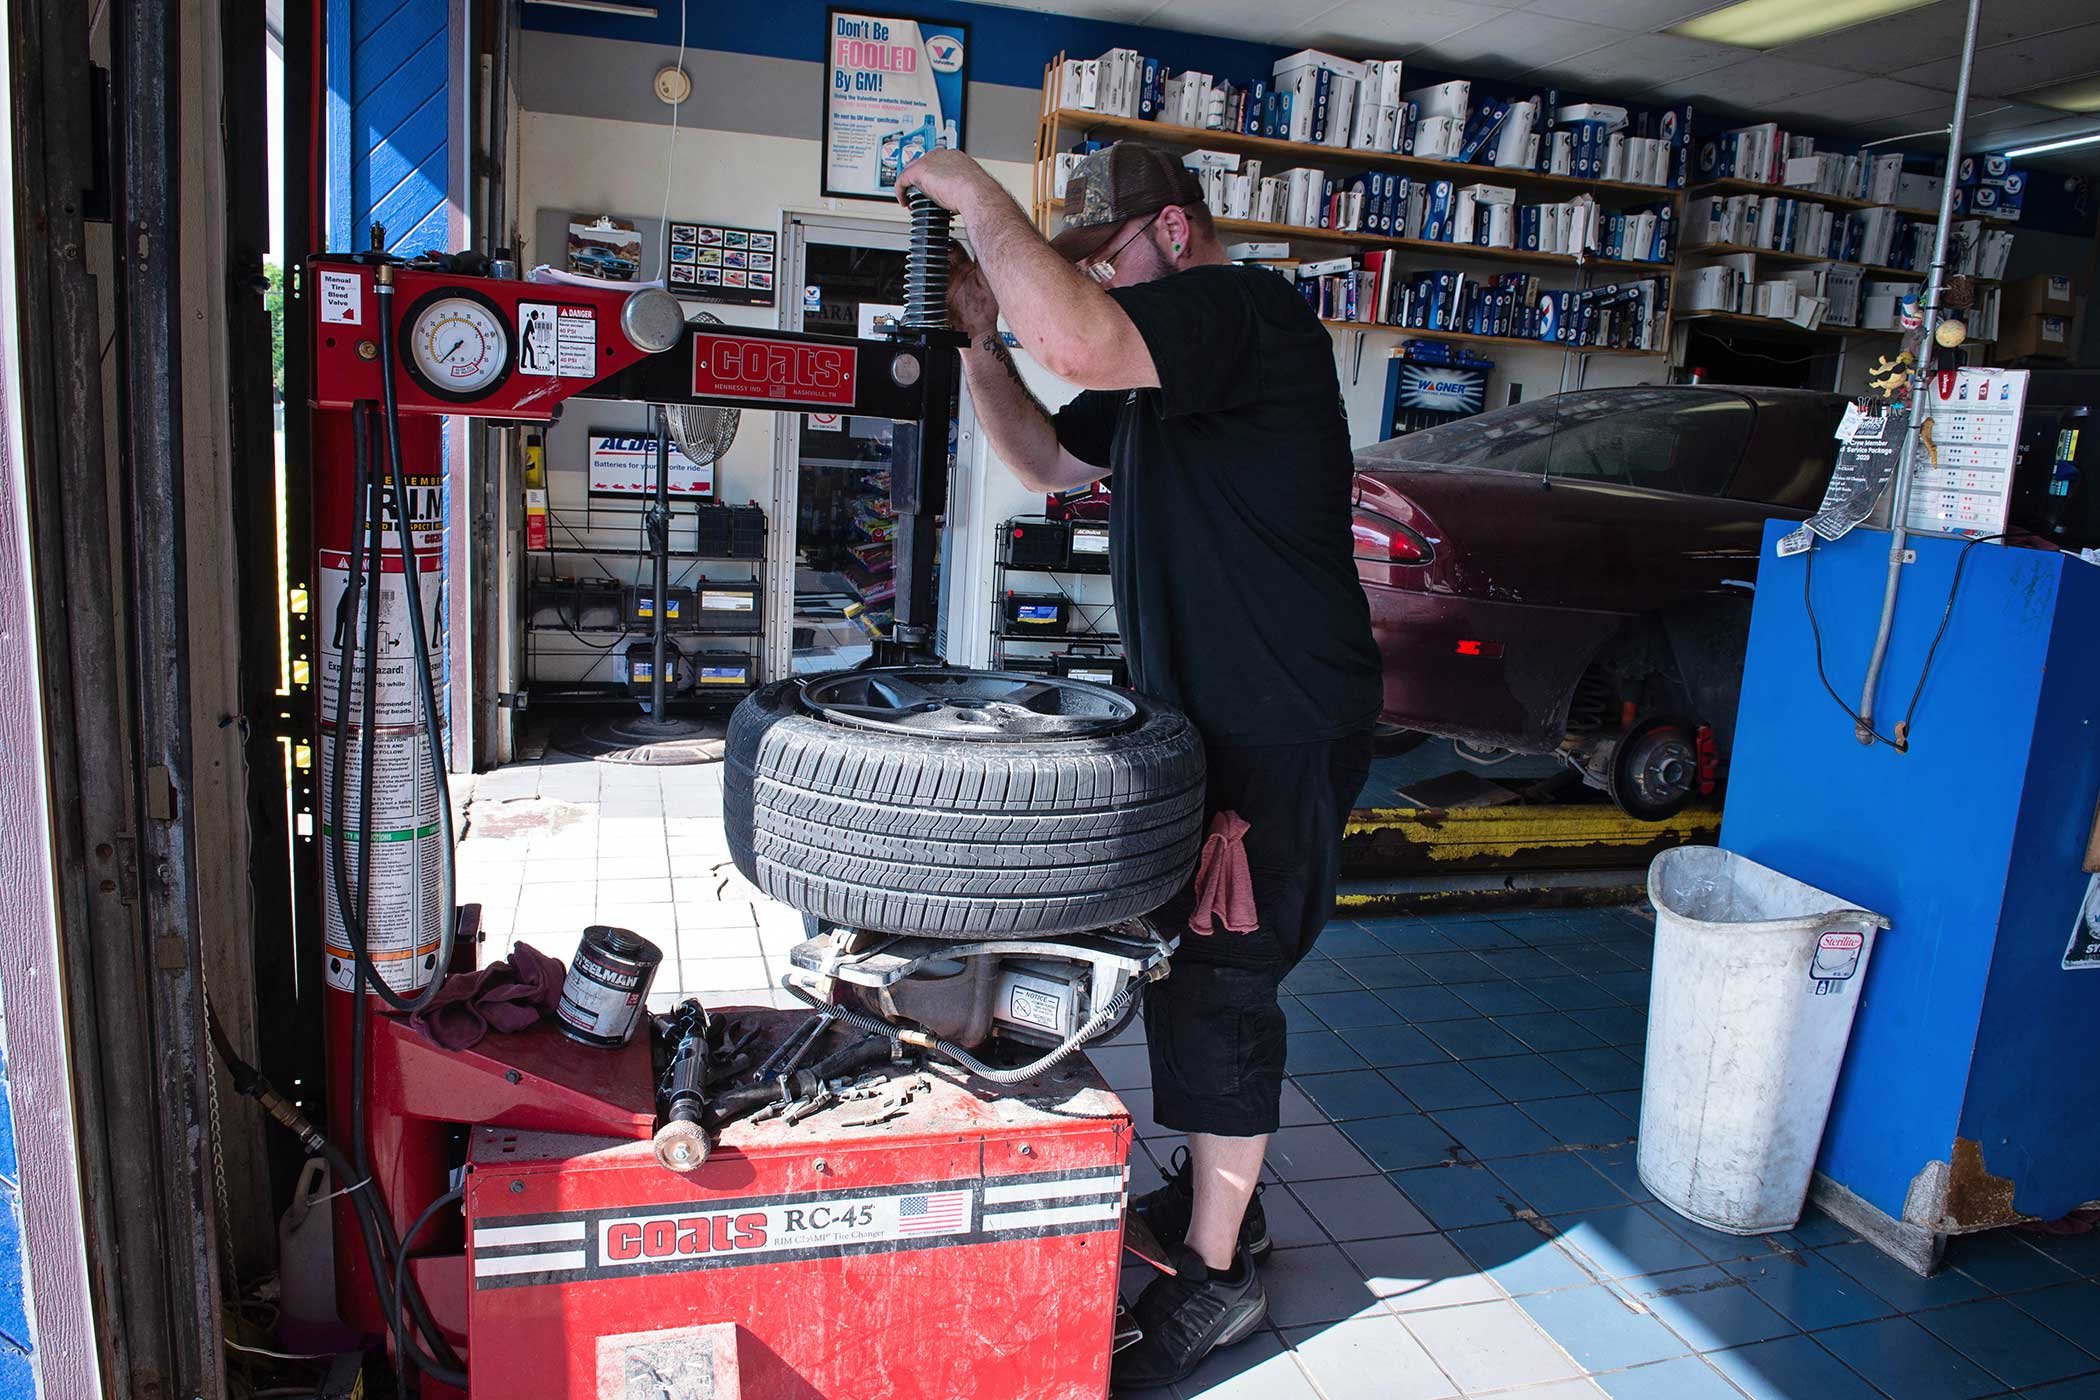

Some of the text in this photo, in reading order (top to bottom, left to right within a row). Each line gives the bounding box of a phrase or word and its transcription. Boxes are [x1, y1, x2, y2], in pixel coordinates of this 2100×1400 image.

[837, 17, 889, 41] Don't Be
[836, 40, 917, 73] FOOLED
[835, 70, 883, 92] By GM!
[569, 309, 592, 318] DANGER
[714, 383, 748, 392] HENNESSY
[599, 437, 682, 454] ACDec
[1846, 446, 1893, 455] Service Package
[594, 460, 627, 469] Batteries
[628, 461, 639, 469] for
[376, 665, 404, 674] azard!
[2085, 943, 2100, 954] SY
[575, 950, 639, 987] STEELMAN
[1026, 991, 1048, 1003] NOTICE
[784, 1203, 875, 1233] RC-45
[774, 1237, 793, 1247] RIM
[833, 1232, 849, 1241] Tire
[850, 1229, 885, 1241] Changer
